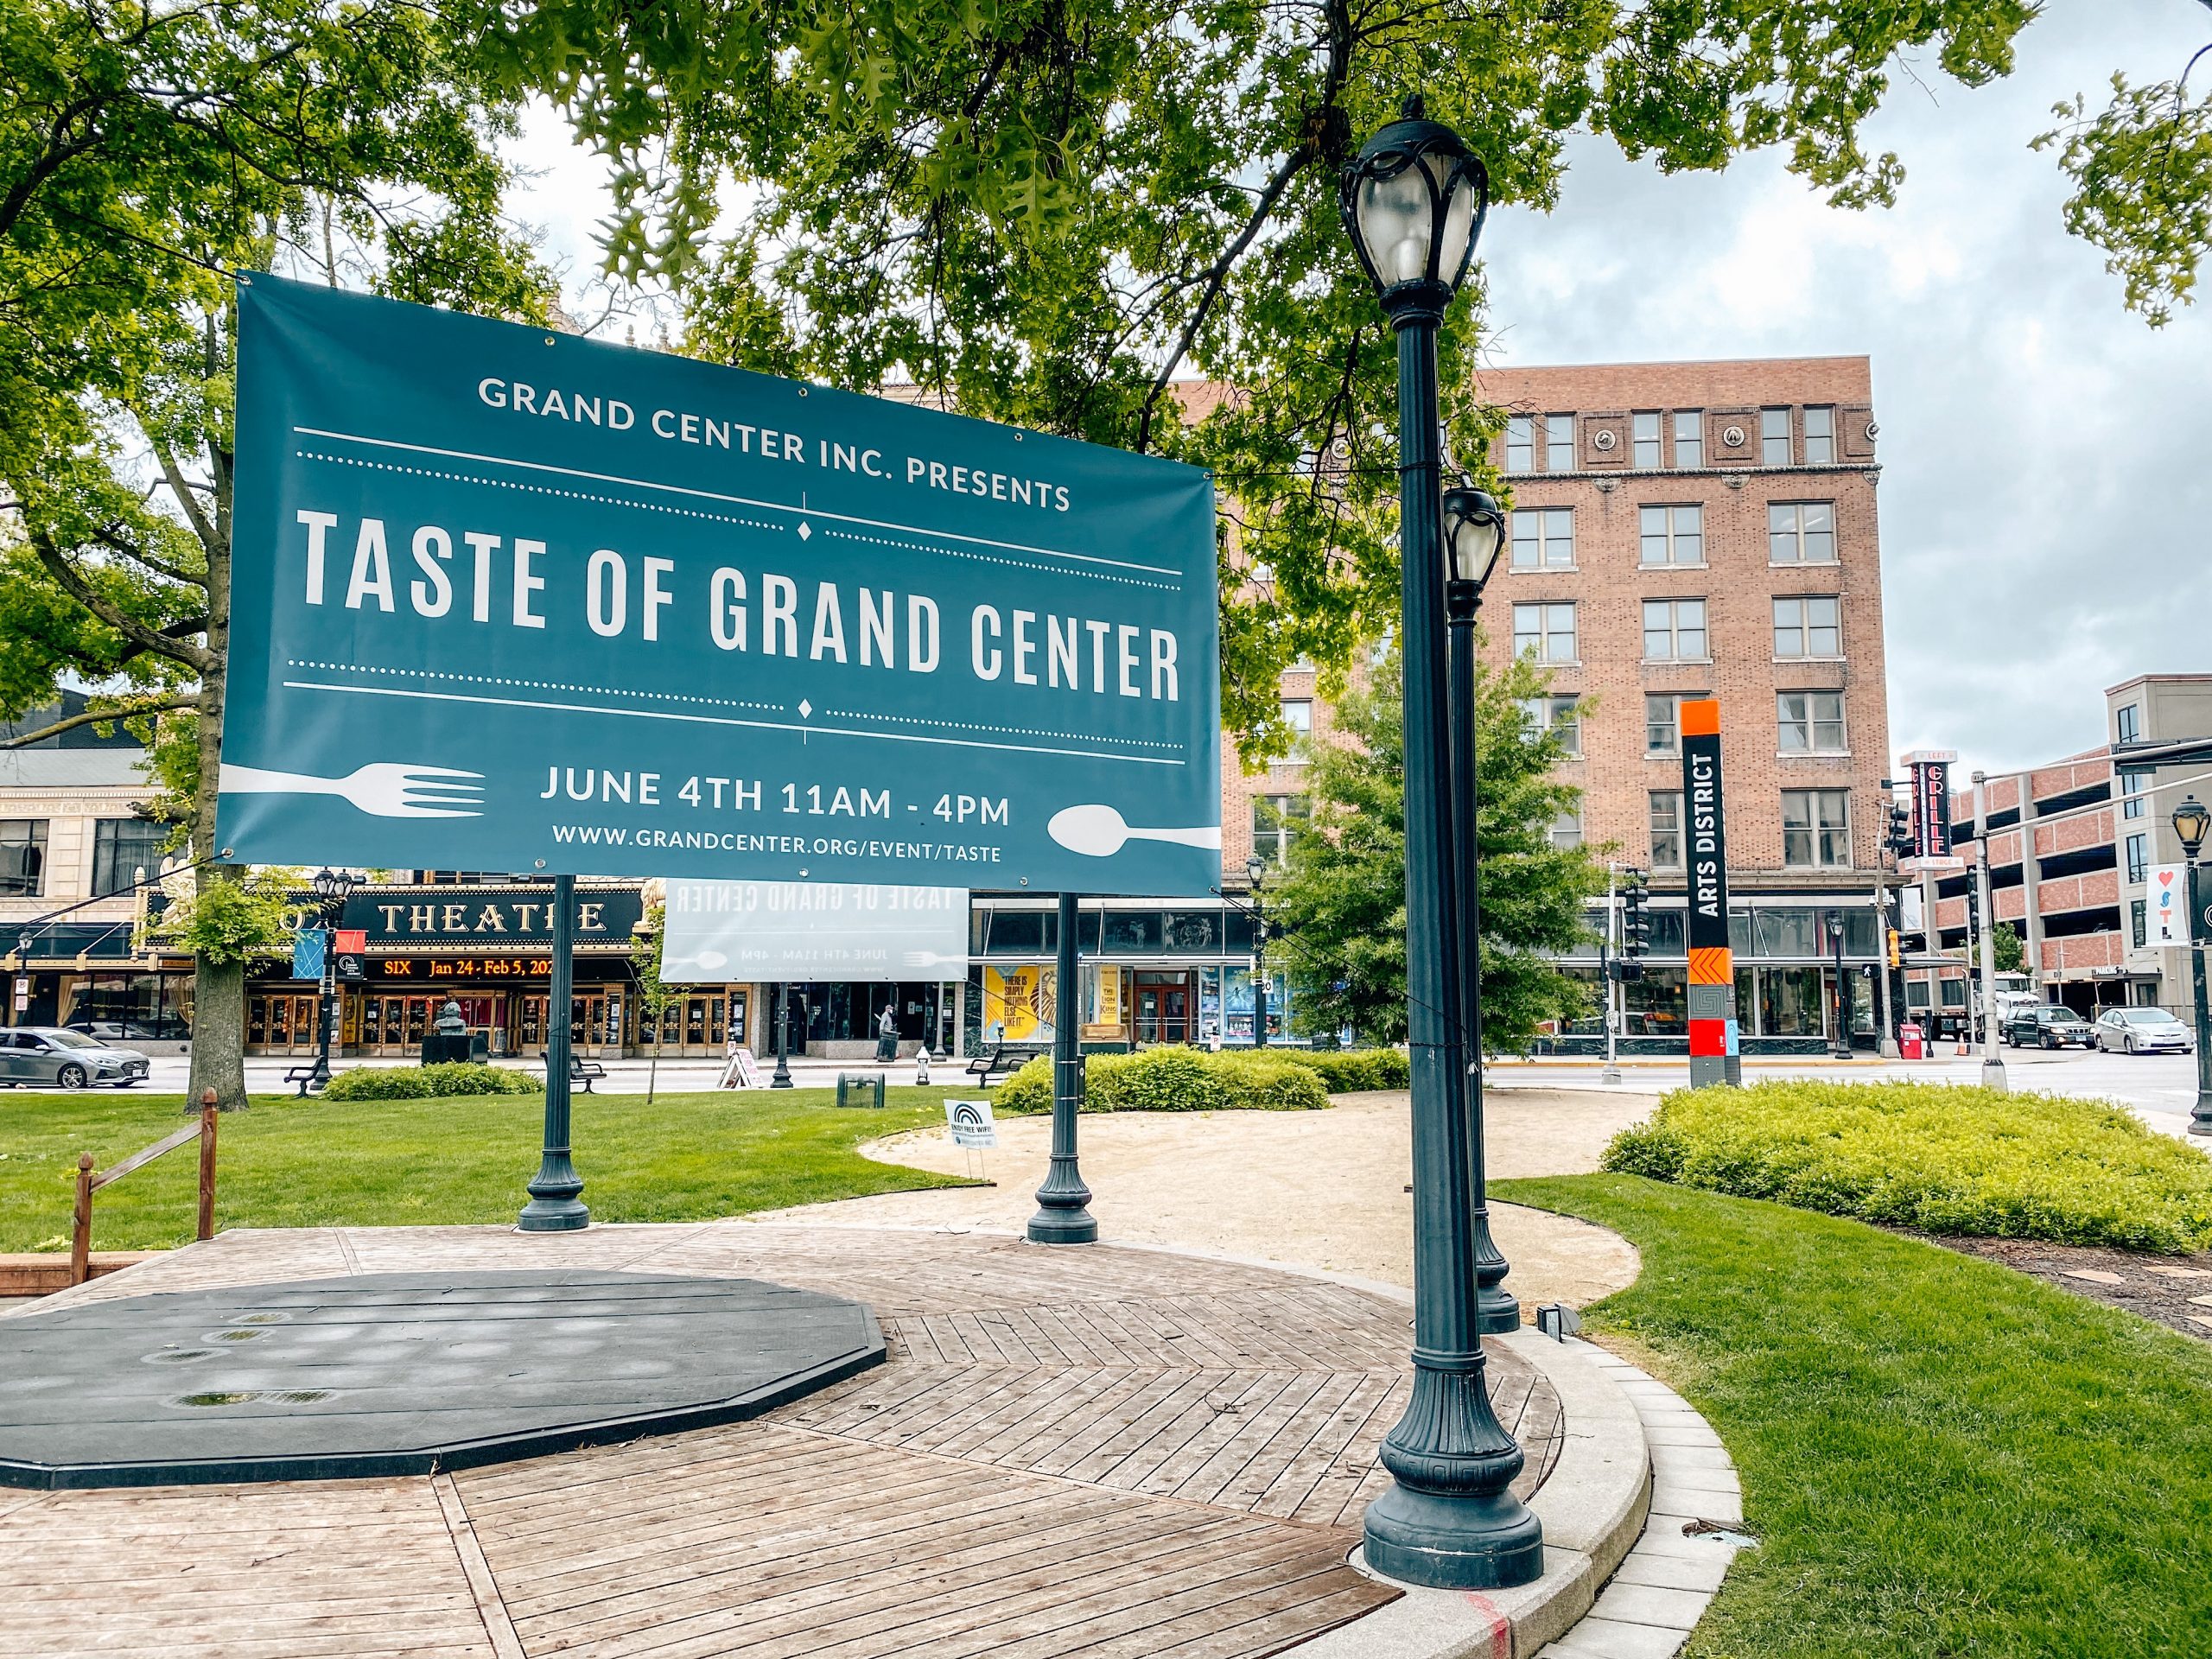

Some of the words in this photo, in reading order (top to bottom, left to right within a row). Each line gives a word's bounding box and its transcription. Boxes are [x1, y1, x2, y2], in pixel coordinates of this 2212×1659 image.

[478, 378, 635, 430] GRAND
[652, 410, 805, 463] CENTER
[820, 440, 893, 480] INC.
[907, 457, 1071, 512] PRESENTS
[296, 509, 547, 630] TASTE
[586, 549, 674, 642] OF
[709, 567, 940, 673] GRAND
[970, 604, 1179, 702] CENTER
[540, 766, 661, 805] JUNE
[677, 776, 762, 810] 4TH
[781, 782, 891, 819] 11AM
[932, 793, 1010, 826] 4PM
[1692, 753, 1716, 853] DISTRICT
[1928, 766, 1946, 855] GRILLE
[552, 824, 1001, 863] WWW.GRANDCENTER.ORG/EVENT/TASTE
[1696, 861, 1719, 917] ARTS
[2159, 891, 2173, 940] STL
[385, 961, 410, 974] SIX
[429, 961, 452, 977] Jan
[456, 960, 474, 975] 24
[484, 960, 509, 974] Feb
[512, 960, 525, 976] 5,
[1004, 986, 1025, 995] SIMPLY
[1004, 1007, 1016, 1016] ELSE
[1004, 1017, 1015, 1027] LIKE
